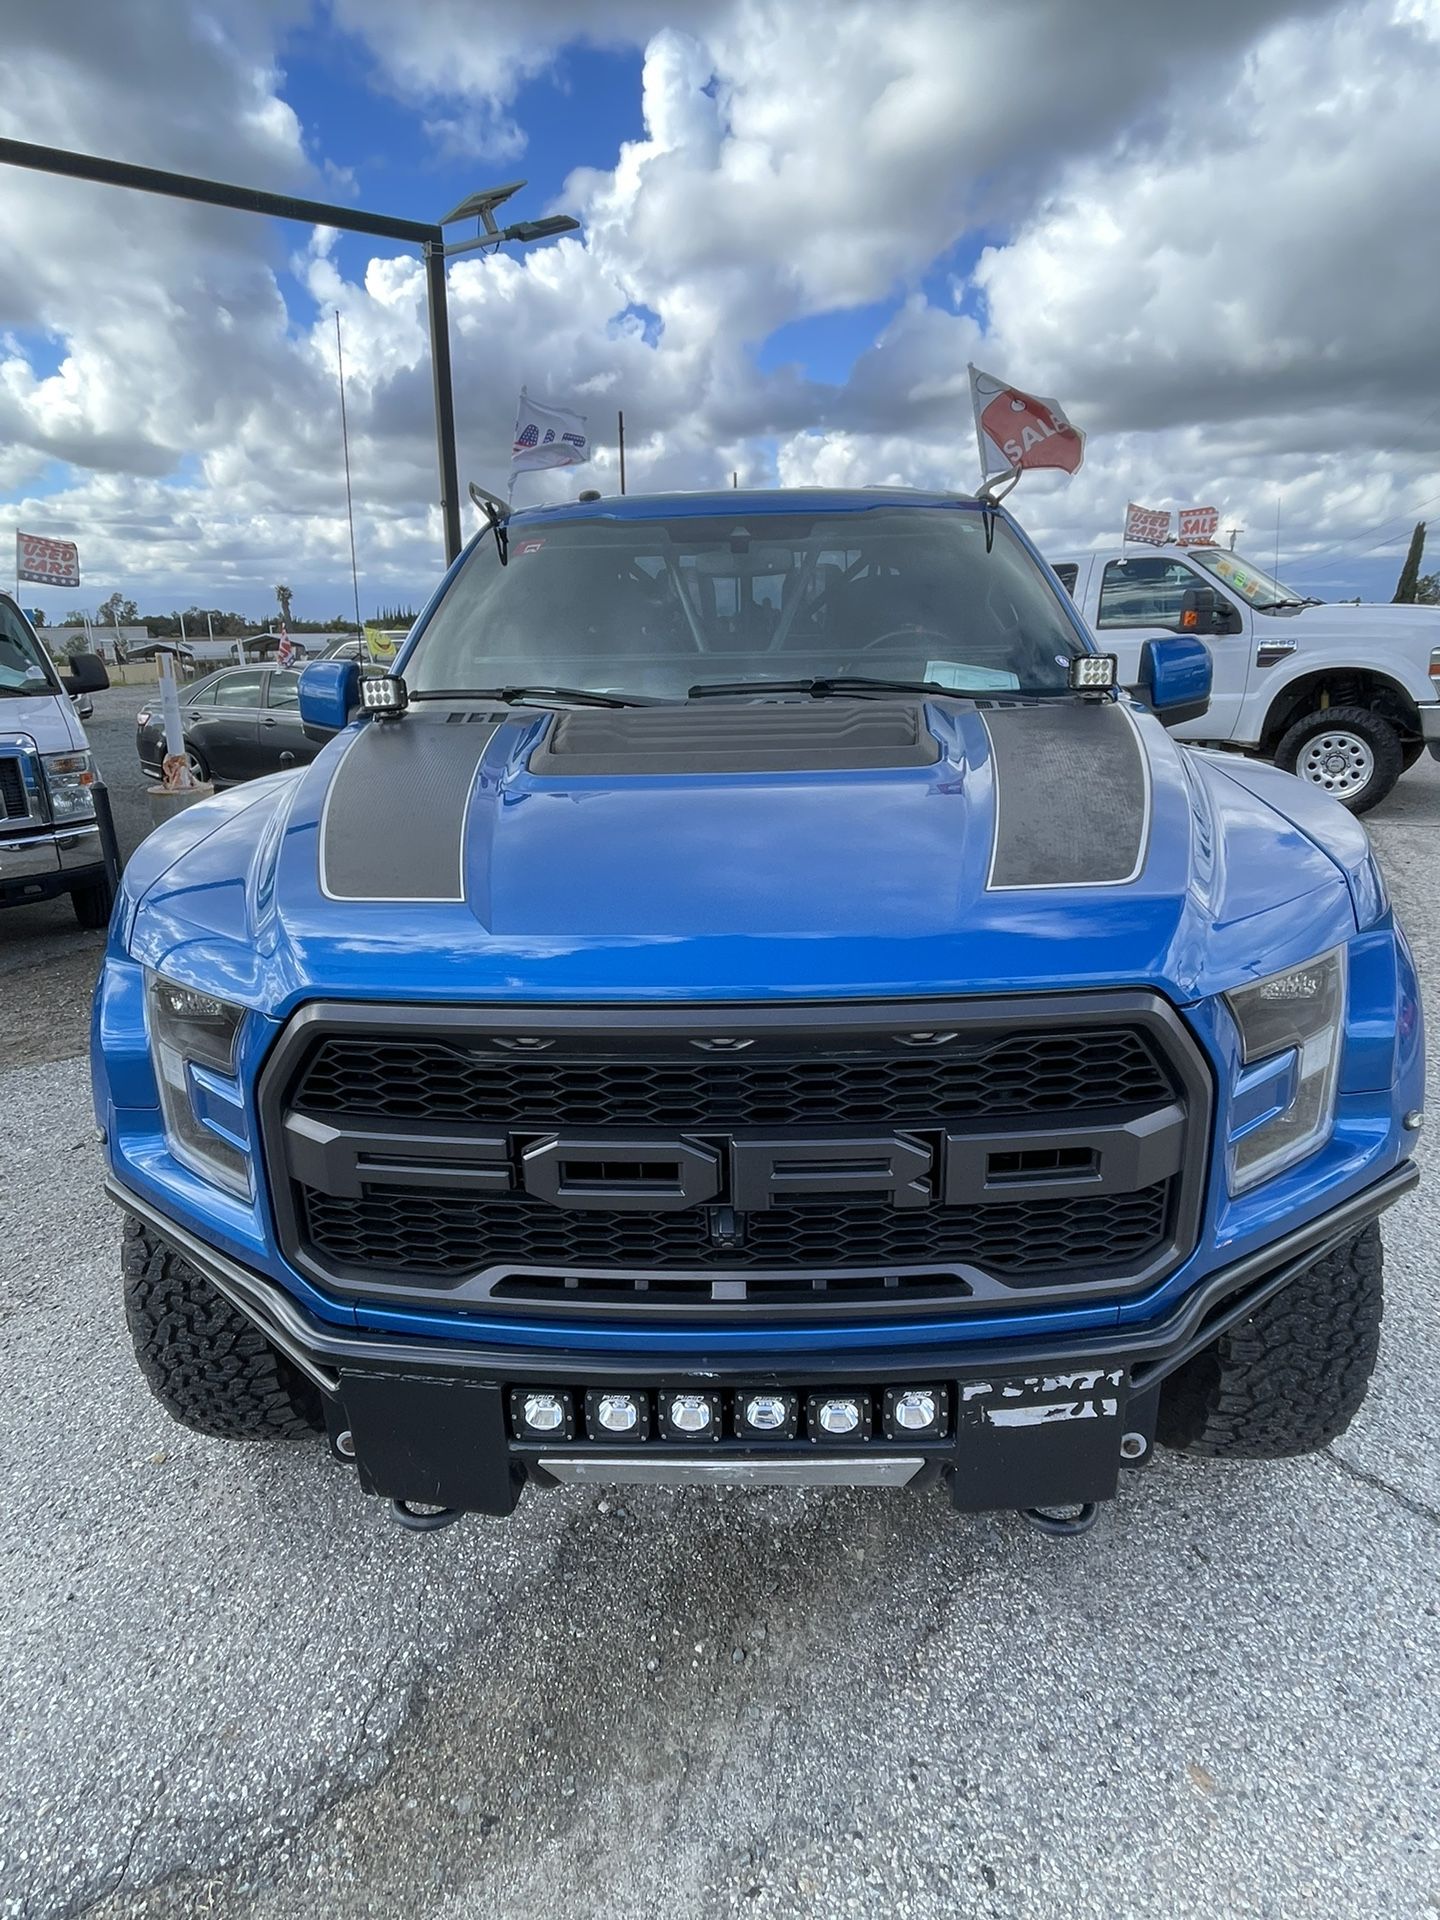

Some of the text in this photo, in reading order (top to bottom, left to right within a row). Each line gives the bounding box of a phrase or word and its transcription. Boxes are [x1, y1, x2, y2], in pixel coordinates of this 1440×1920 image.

[1131, 512, 1169, 527] USED
[1182, 516, 1218, 535] SALE
[1128, 523, 1167, 538] CARS
[23, 543, 75, 562] USED
[23, 557, 75, 576] CARS
[285, 1103, 1187, 1212] FORD
